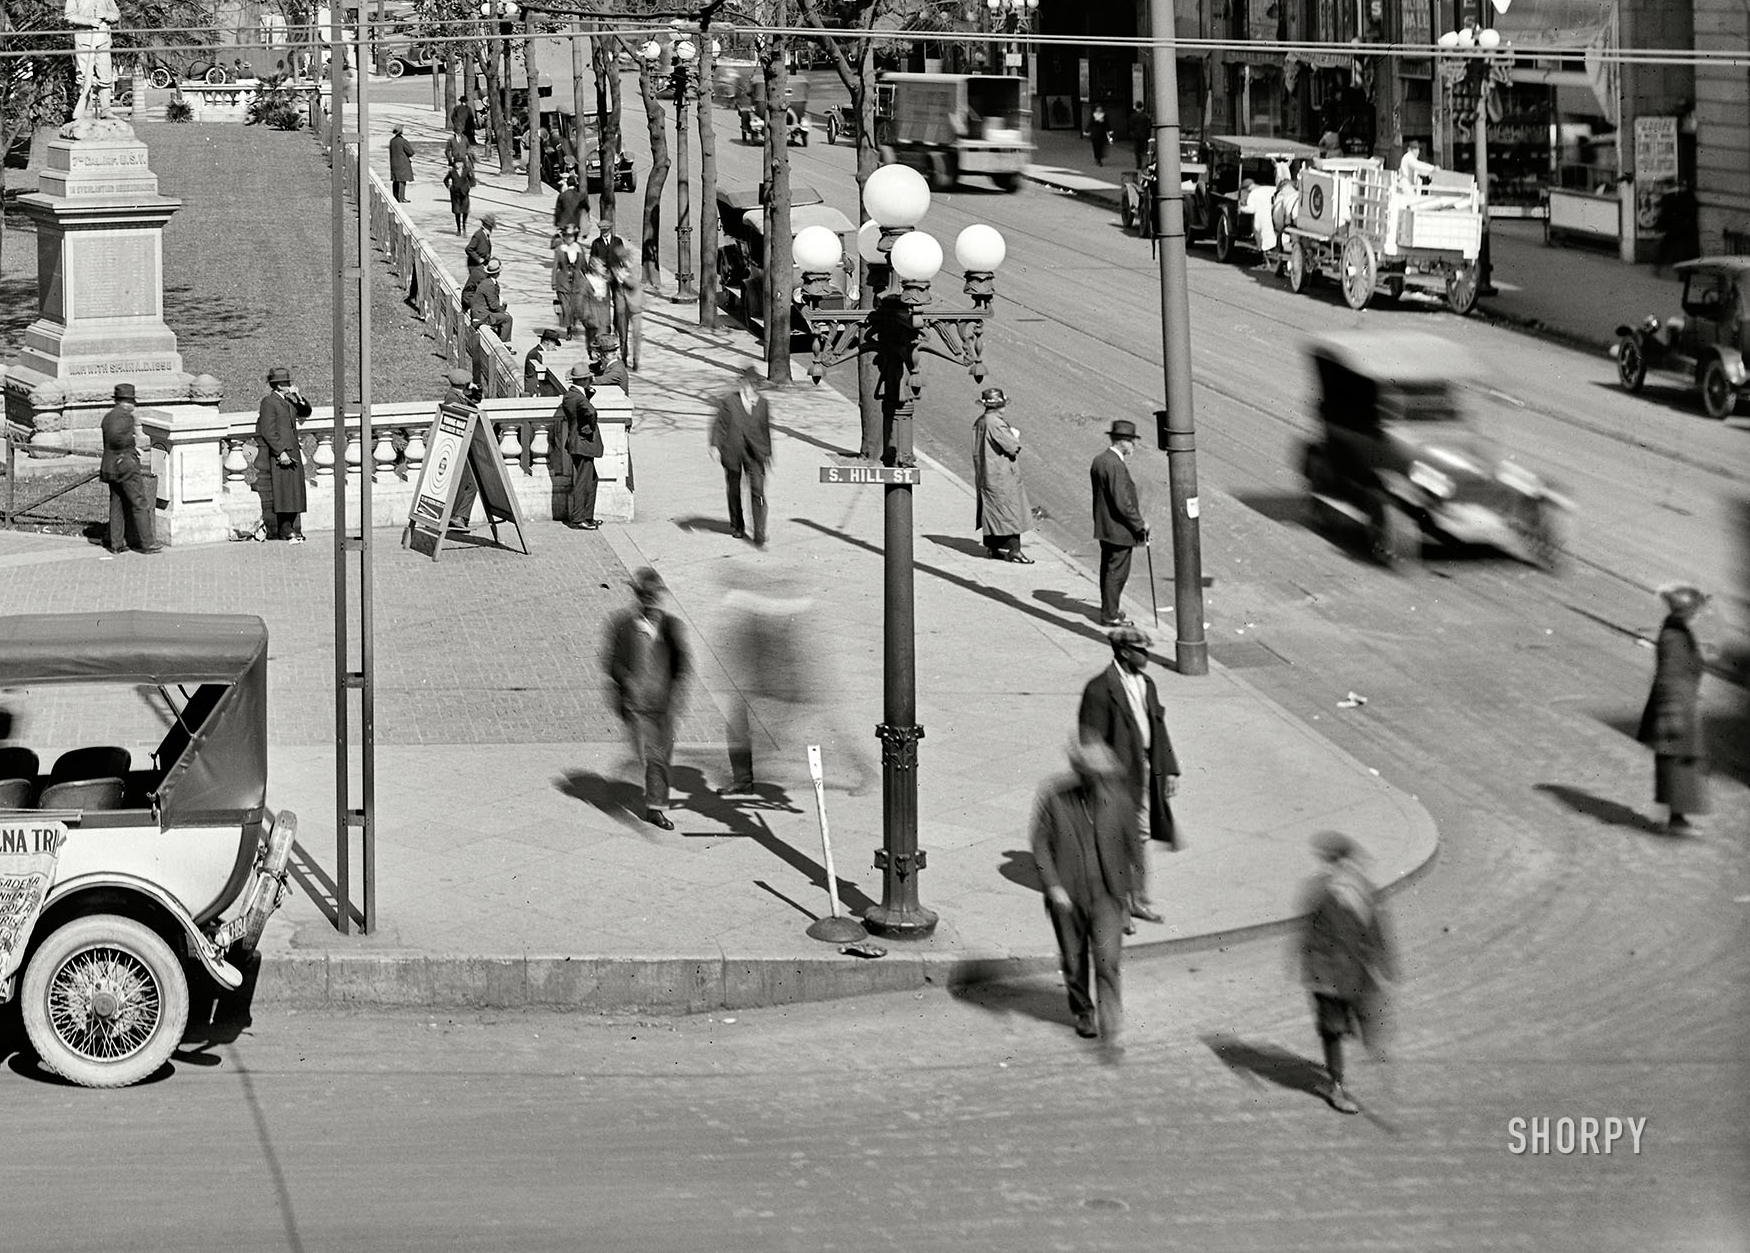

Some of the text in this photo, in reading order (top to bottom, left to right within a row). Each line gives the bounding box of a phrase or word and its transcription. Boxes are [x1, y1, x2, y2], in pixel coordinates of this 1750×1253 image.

[829, 468, 914, 484] S. HILL ST.
